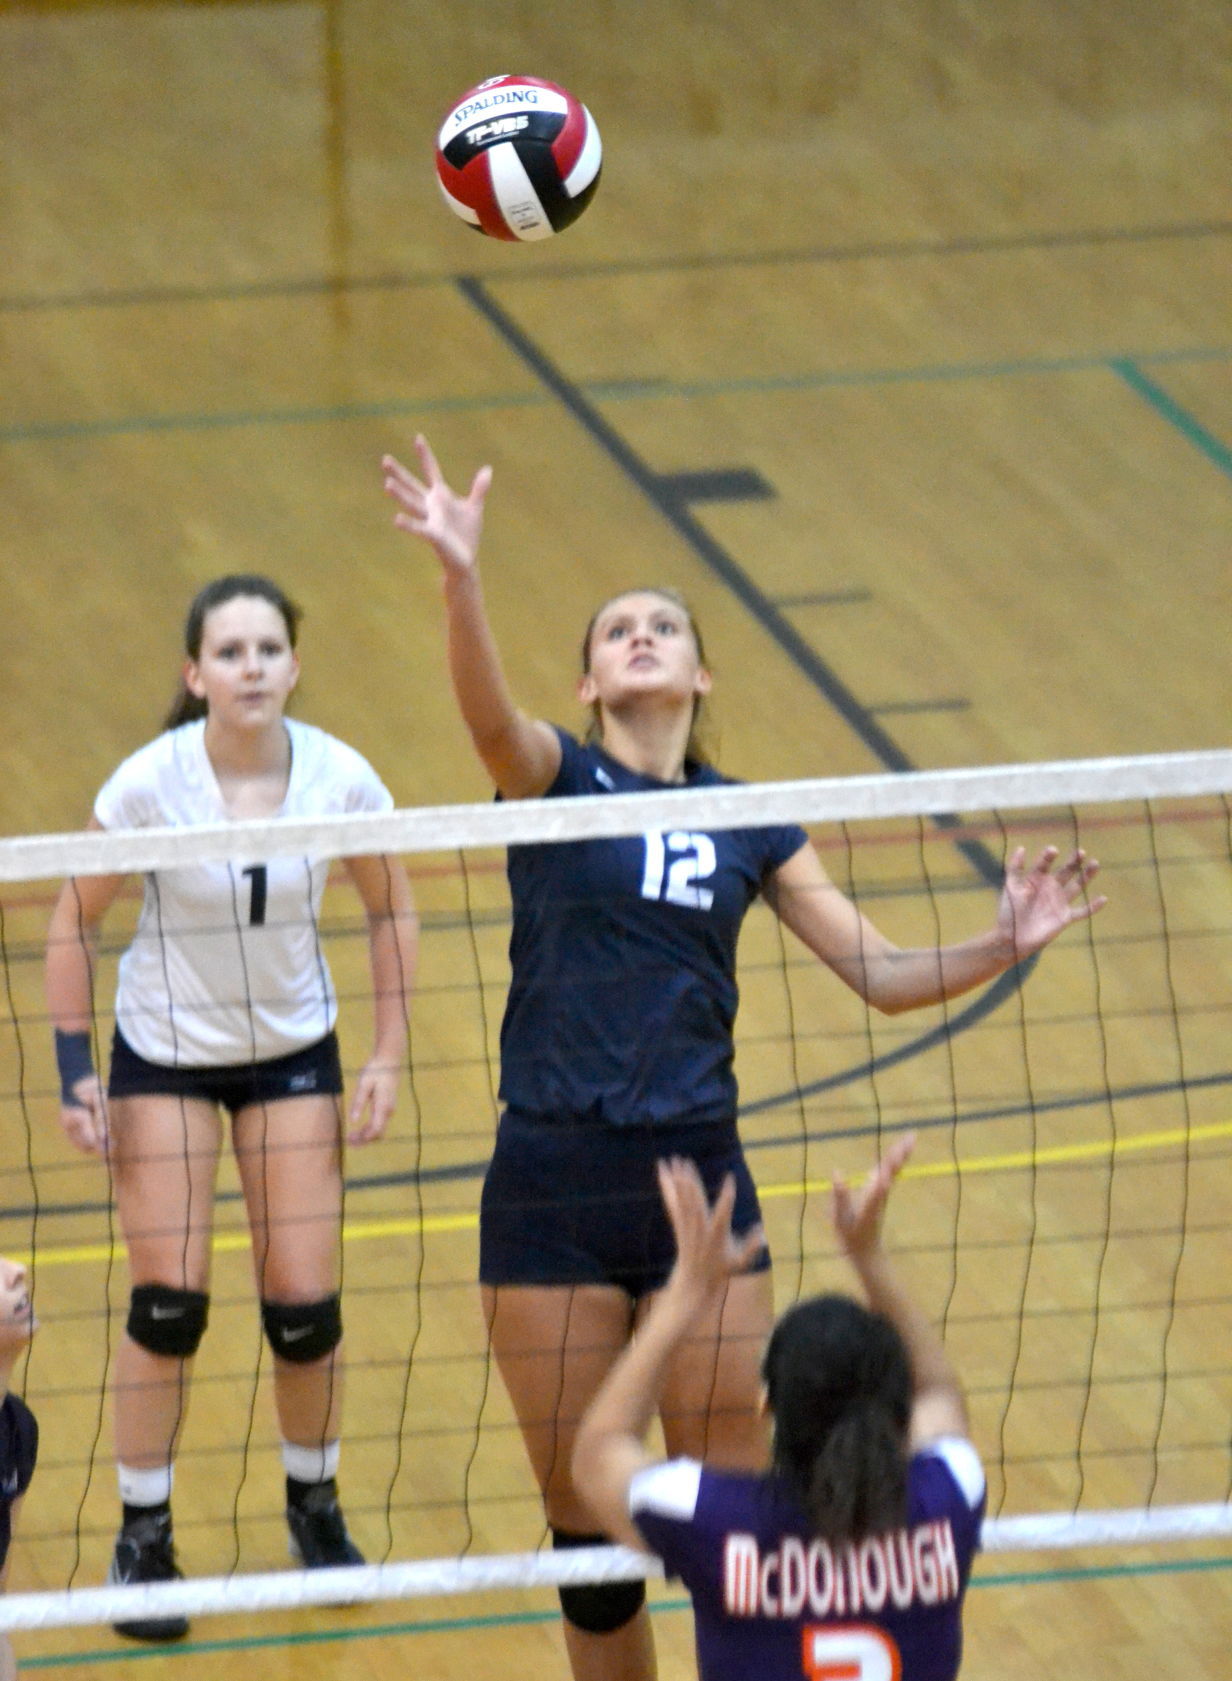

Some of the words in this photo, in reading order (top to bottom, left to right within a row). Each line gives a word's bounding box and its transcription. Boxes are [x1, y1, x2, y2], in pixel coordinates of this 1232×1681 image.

[453, 89, 539, 127] SPALDING
[241, 863, 267, 927] 1
[641, 829, 717, 912] 12
